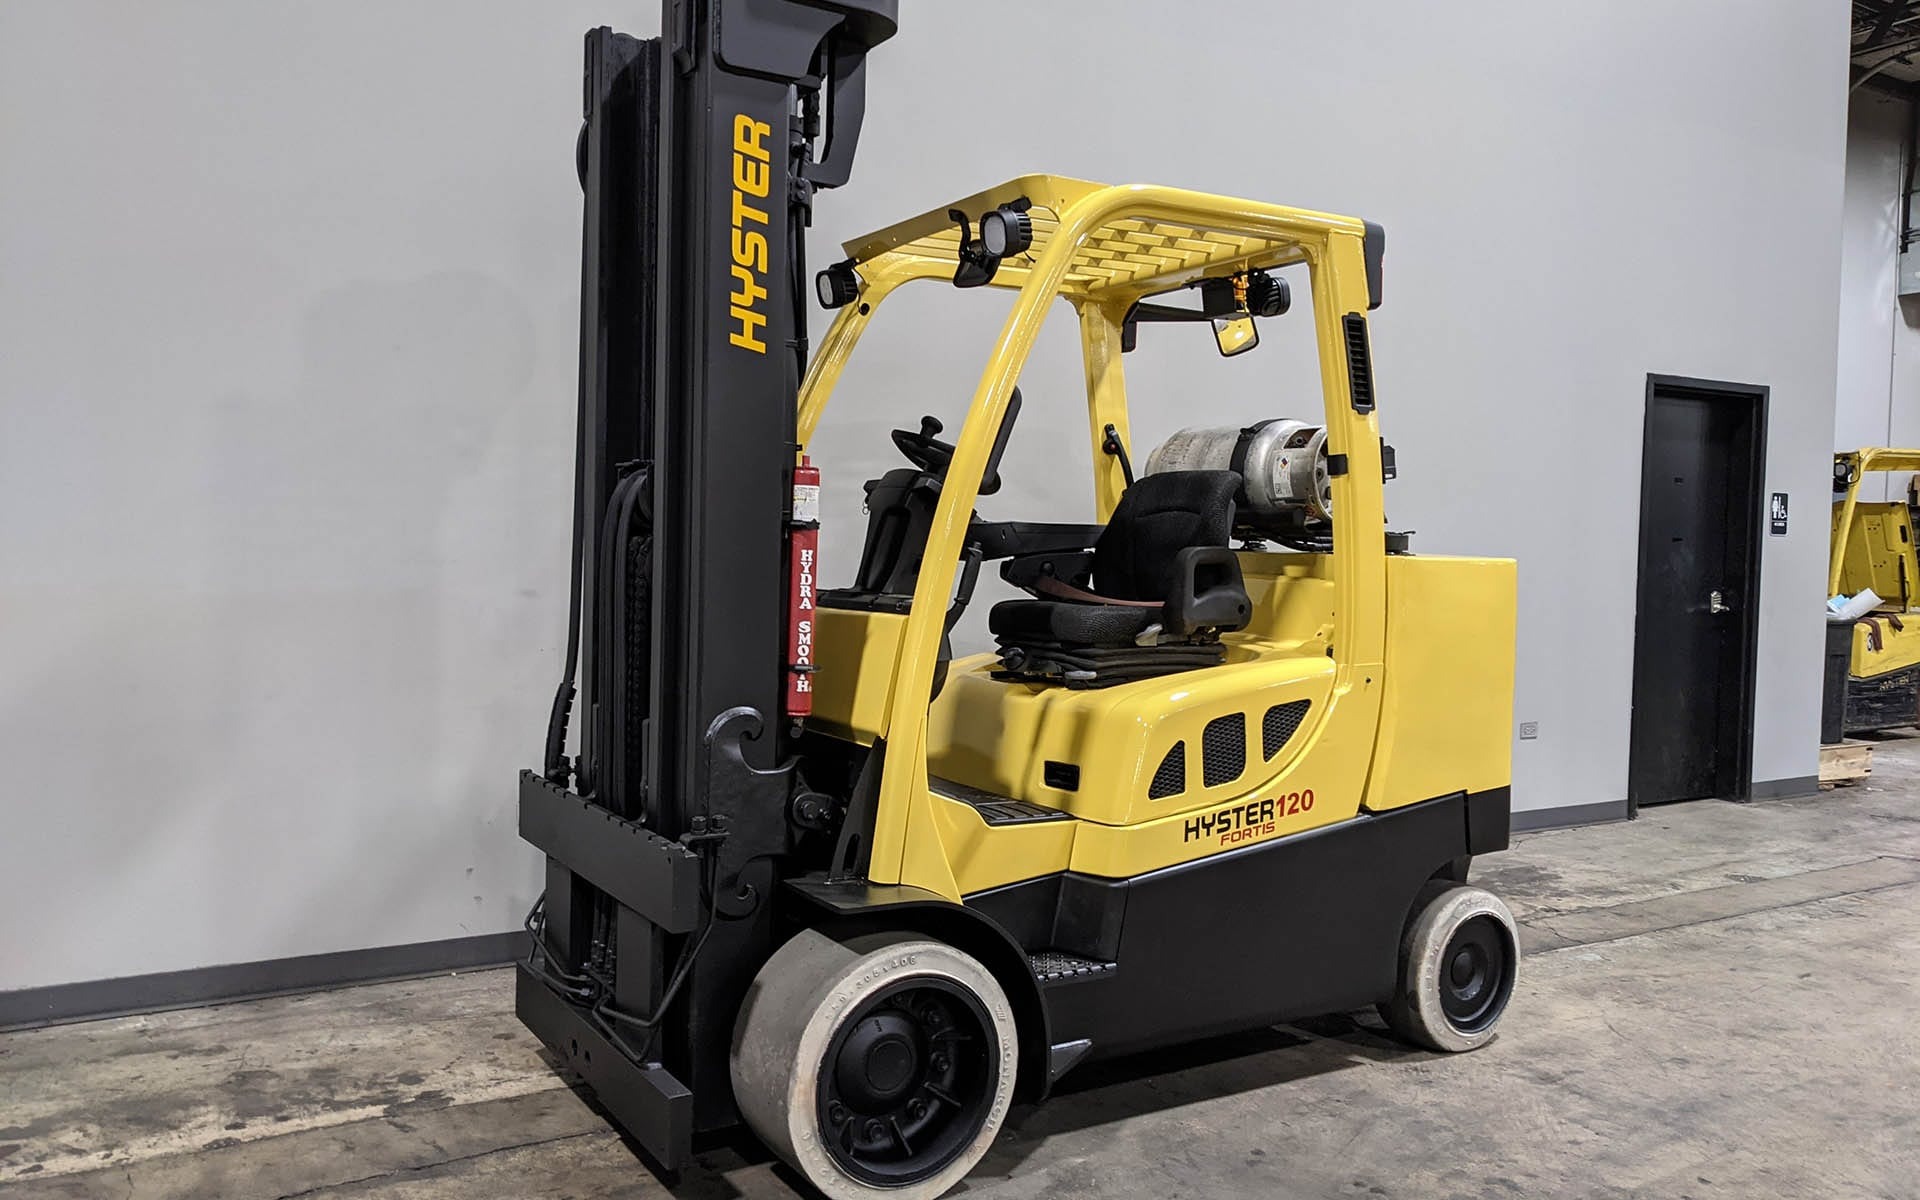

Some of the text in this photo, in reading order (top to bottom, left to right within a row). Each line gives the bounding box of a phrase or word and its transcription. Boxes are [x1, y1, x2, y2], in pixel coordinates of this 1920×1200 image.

[730, 114, 771, 354] HYSTER
[799, 549, 814, 610] HYDRA
[1184, 789, 1315, 843] HYSTER 120
[1219, 820, 1277, 847] FORTIS
